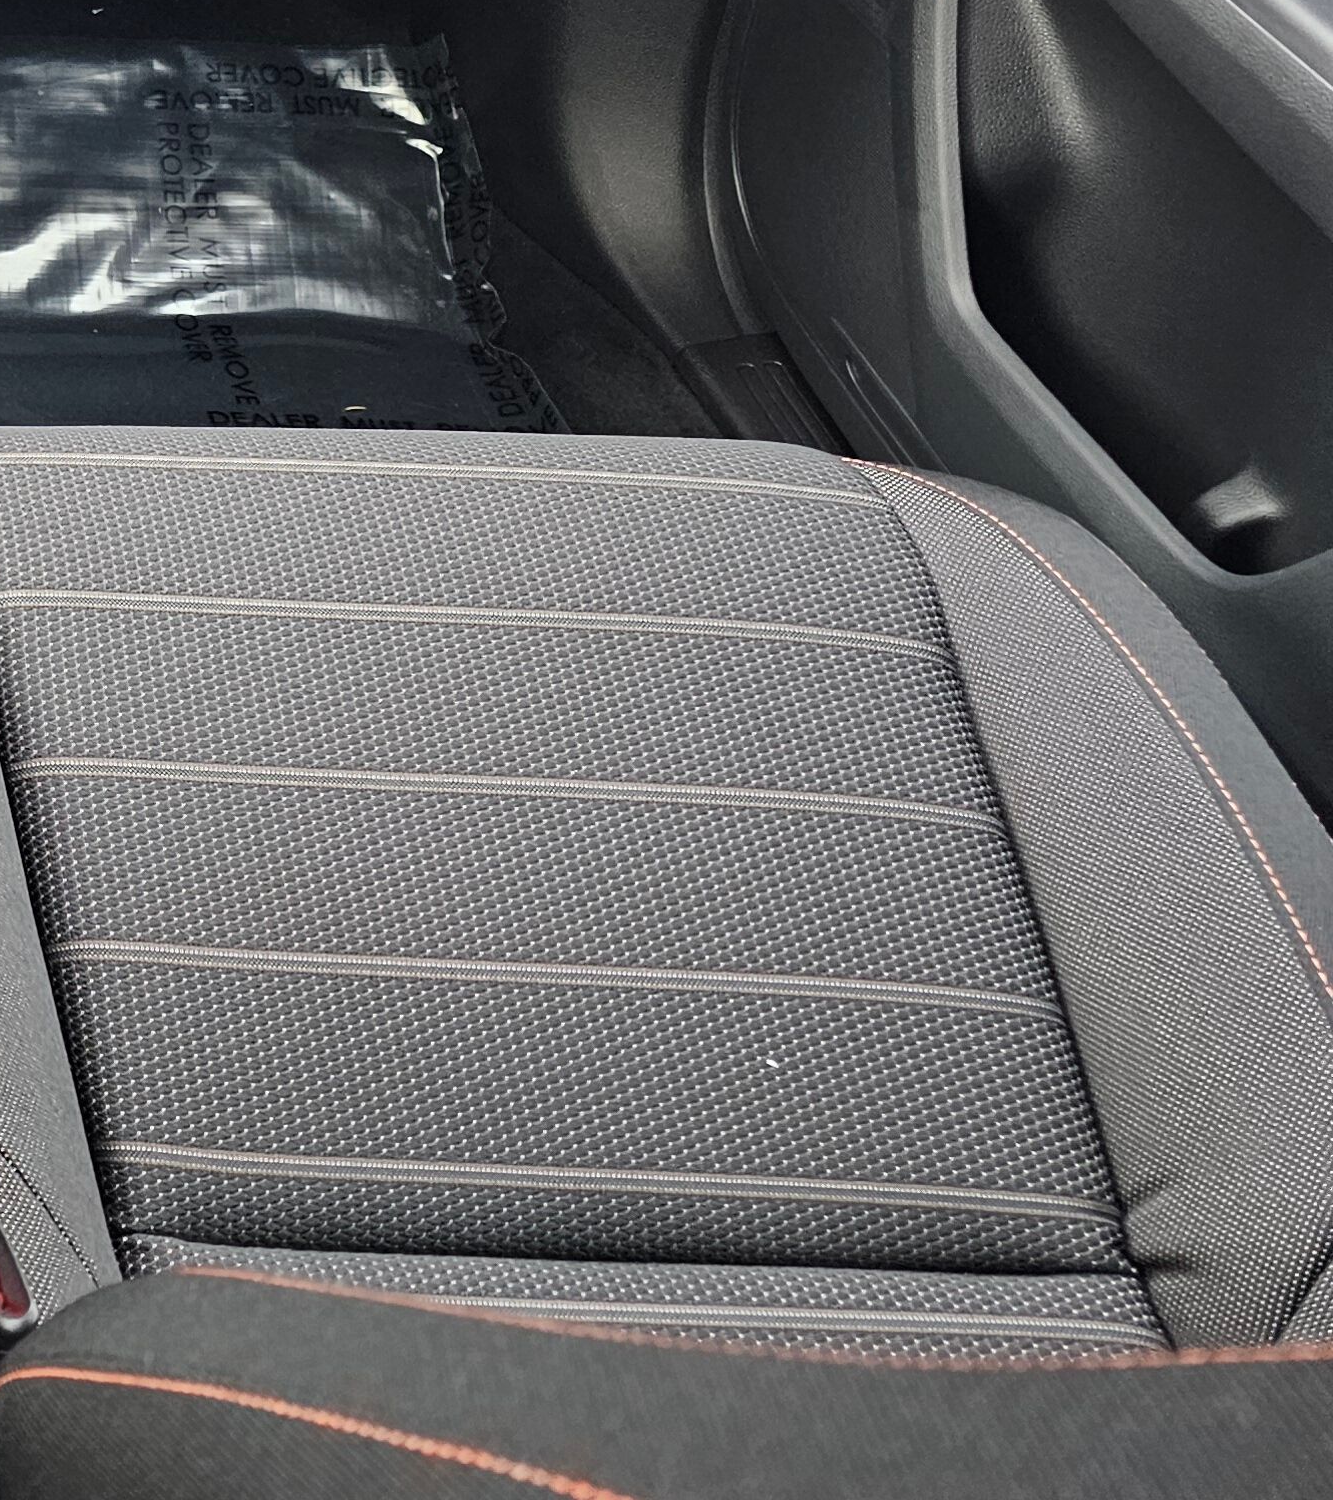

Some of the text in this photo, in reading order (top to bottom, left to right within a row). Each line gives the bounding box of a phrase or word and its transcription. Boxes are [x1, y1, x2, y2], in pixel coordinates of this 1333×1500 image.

[289, 91, 360, 116] MUST
[157, 120, 192, 280] PROTECTIVE
[186, 122, 221, 221] DEALER
[211, 323, 260, 407] REMOVE
